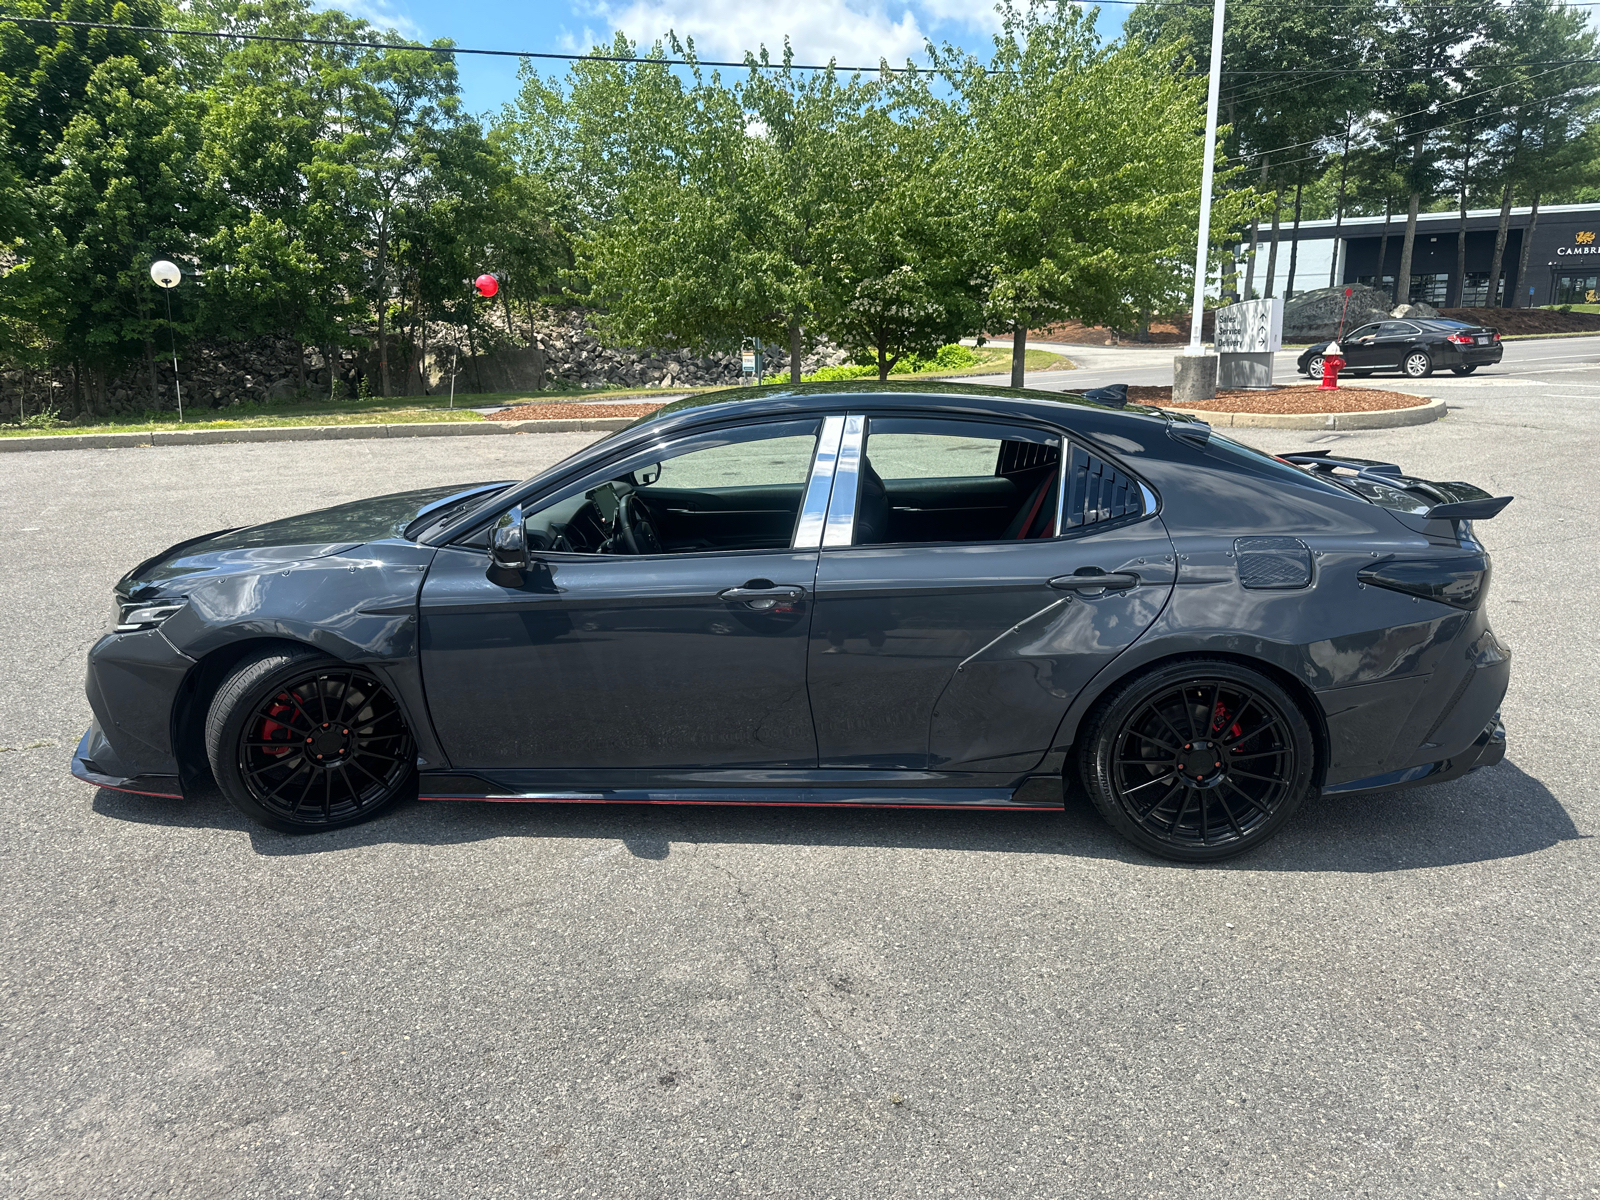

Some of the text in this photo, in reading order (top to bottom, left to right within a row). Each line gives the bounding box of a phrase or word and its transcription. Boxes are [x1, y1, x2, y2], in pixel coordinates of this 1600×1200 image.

[1219, 315, 1236, 323] Sales
[1218, 327, 1241, 335] Service
[1218, 339, 1243, 348] Delivery
